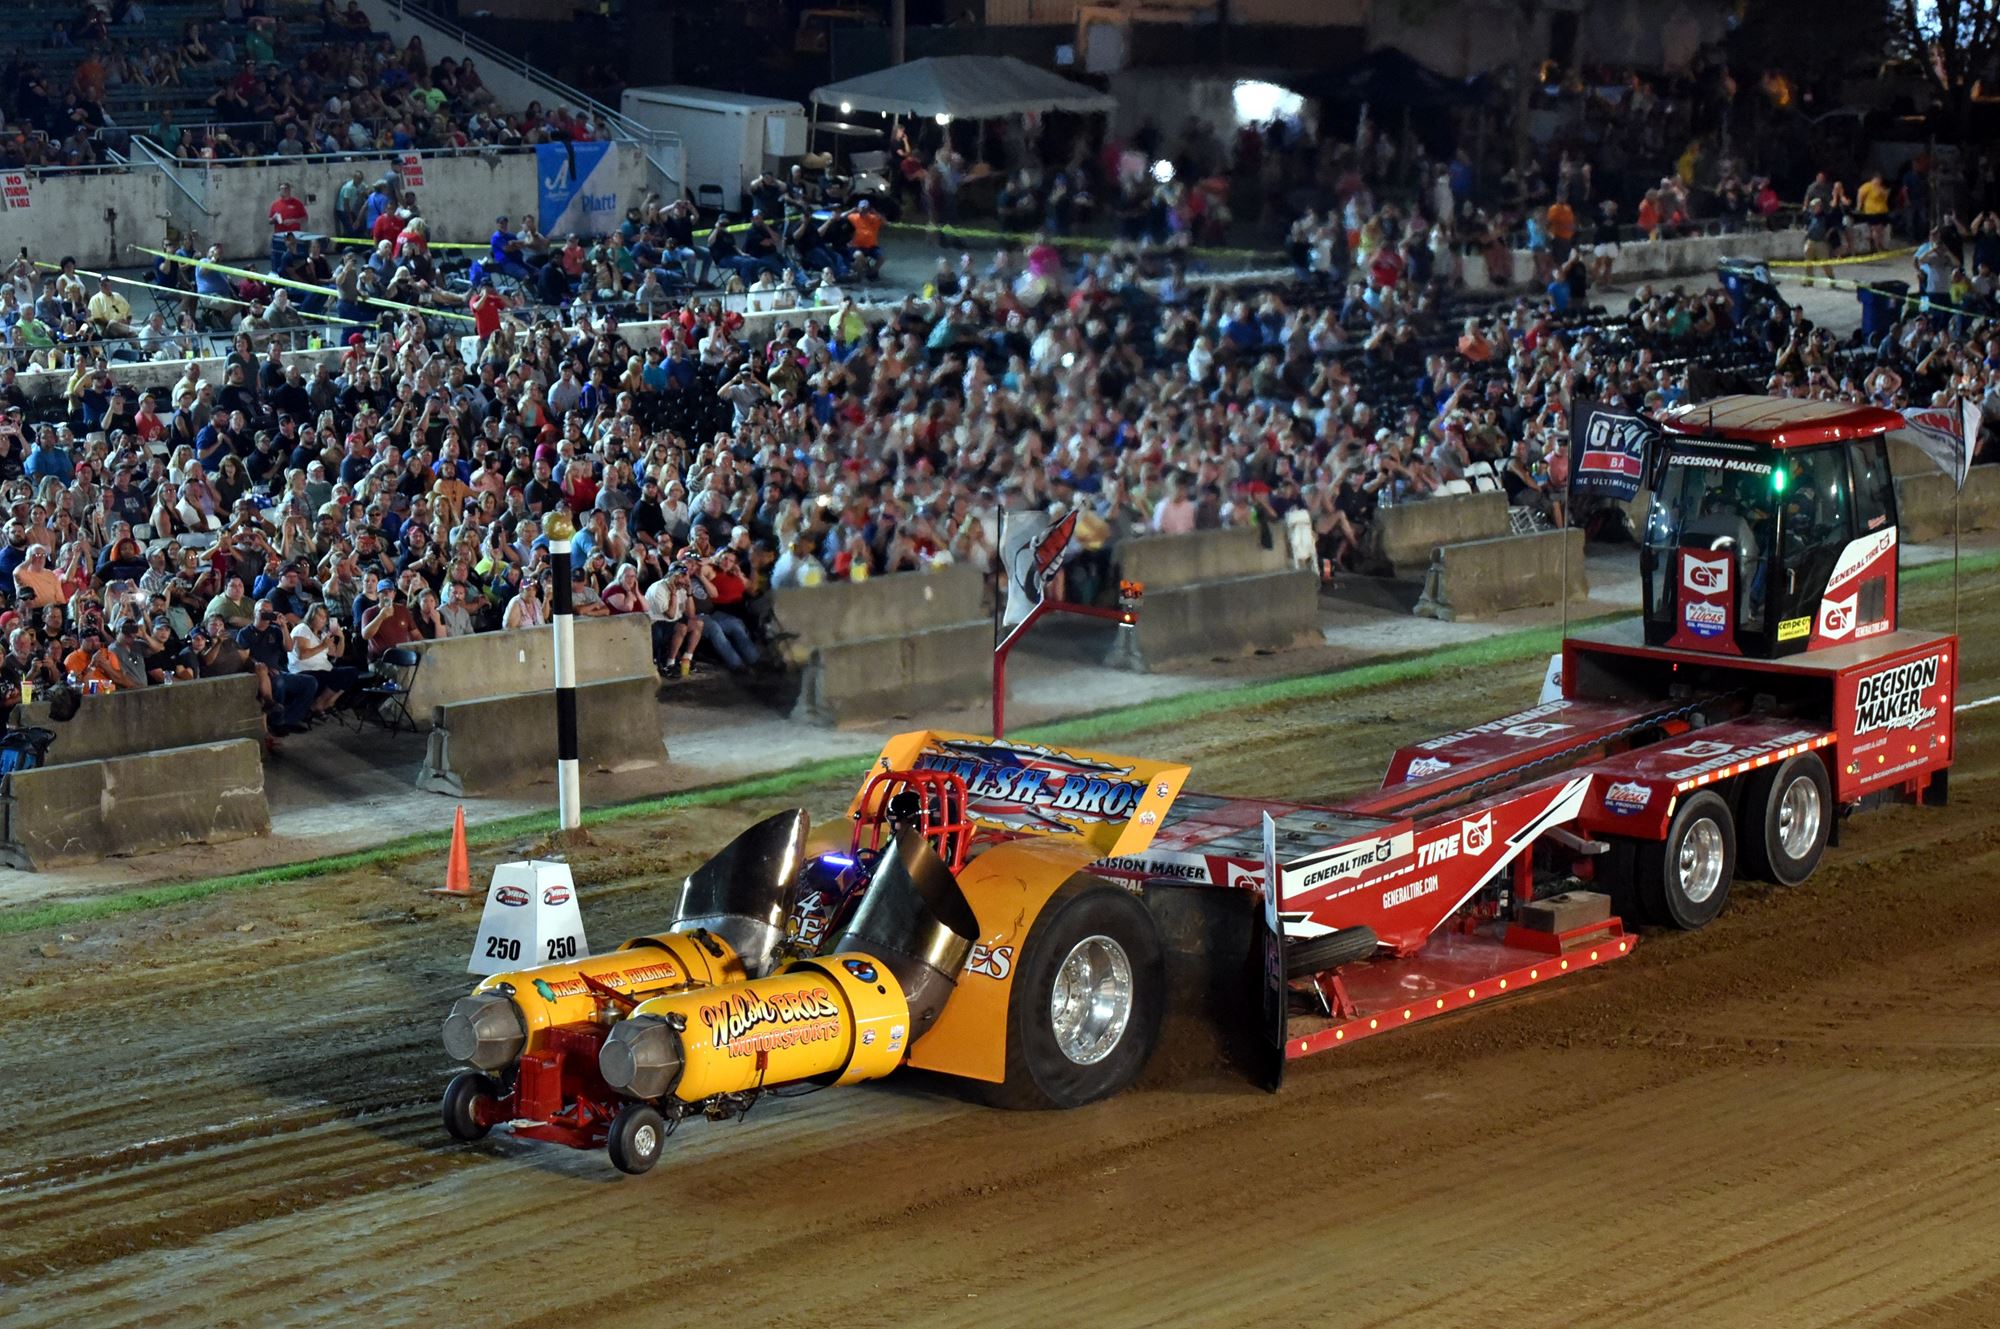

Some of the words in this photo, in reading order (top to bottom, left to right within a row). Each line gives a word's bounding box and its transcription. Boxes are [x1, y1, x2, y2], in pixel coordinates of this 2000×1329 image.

[6, 175, 21, 185] NO
[1669, 455, 1723, 469] DECISION
[1725, 459, 1772, 474] MAKER
[1690, 566, 1723, 588] GT
[1829, 559, 1864, 587] GENERAL
[1690, 611, 1723, 623] LUCAS
[1825, 606, 1852, 631] GT
[1856, 655, 1938, 708] DECISION
[1854, 688, 1921, 735] MAKER
[1666, 745, 1772, 779] GENERAL
[1761, 730, 1818, 748] TIRE
[1612, 789, 1648, 803] LUCAS
[1418, 833, 1461, 868] TIRE
[1150, 861, 1206, 879] MAKER
[1303, 861, 1350, 887] GENERAL
[1352, 851, 1375, 869] TIRE
[1382, 874, 1438, 910] GENERALTIRE.COM
[486, 936, 521, 961] 250
[547, 935, 576, 961] 250
[549, 979, 588, 997] WALSH
[623, 962, 676, 984] TURBINES
[700, 988, 776, 1049] Walsh
[769, 987, 839, 1024] BROS.
[729, 1019, 840, 1058] MOTORSPORTS
